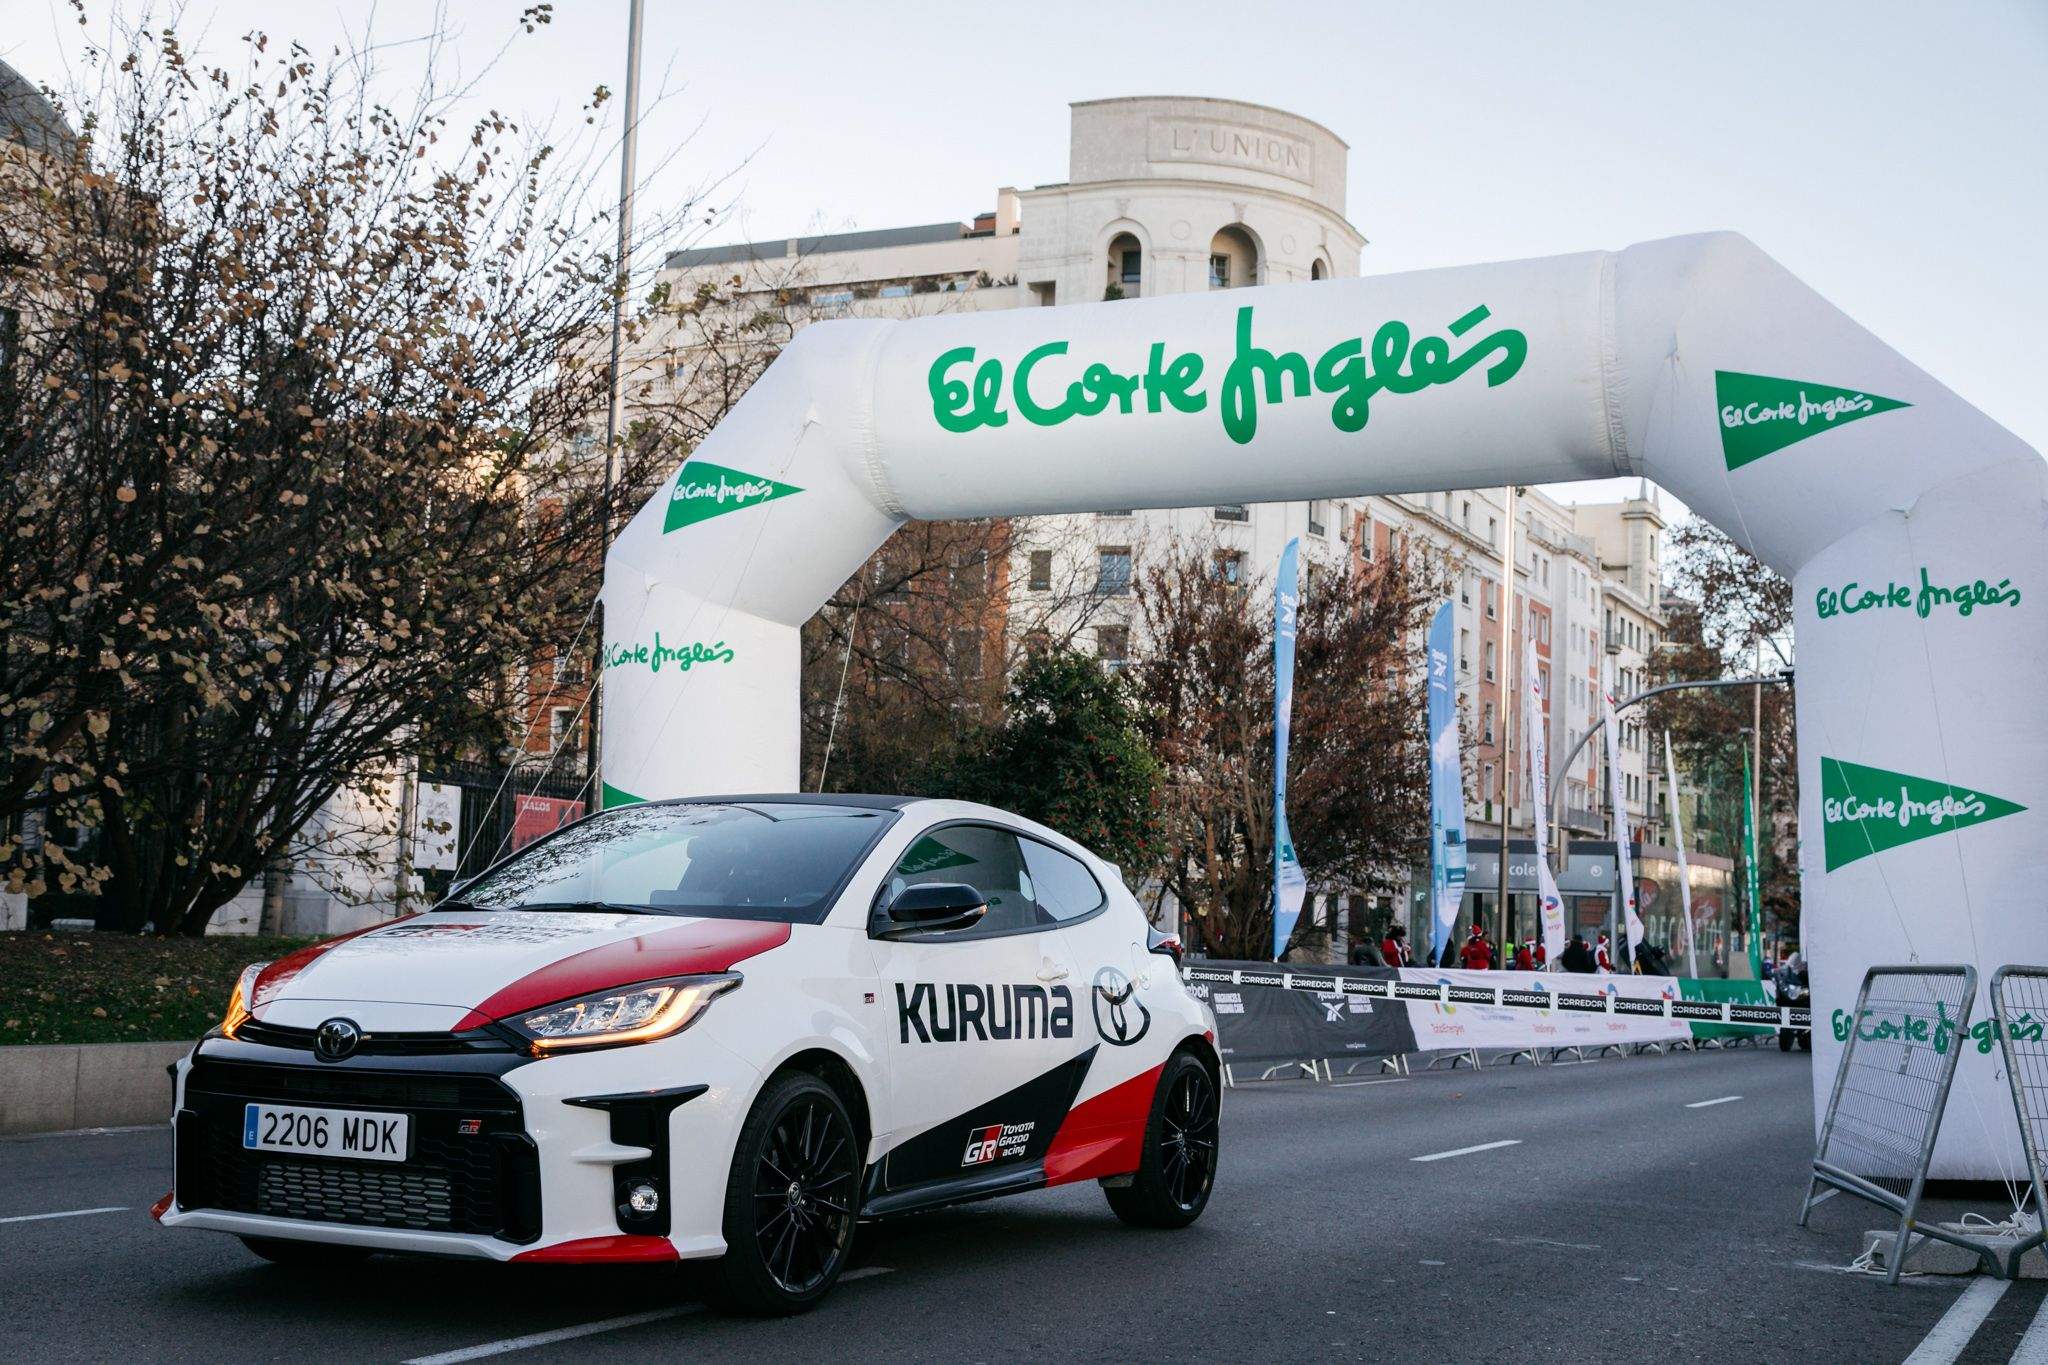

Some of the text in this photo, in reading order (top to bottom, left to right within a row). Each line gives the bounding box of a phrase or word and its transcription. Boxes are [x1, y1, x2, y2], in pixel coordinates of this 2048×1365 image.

[928, 304, 1529, 444] El Corte Inglés
[1721, 390, 1874, 428] El Corte Inglés
[685, 481, 717, 499] Corte
[716, 474, 773, 504] Inglés
[1816, 567, 2021, 619] El Corte Inglés
[651, 631, 734, 673] Inglés
[1824, 786, 1986, 827] El Corte Inglés
[248, 1131, 255, 1141] E
[262, 1112, 399, 1154] 2206 MDK
[999, 1133, 1030, 1147] GAZOO
[1003, 1121, 1035, 1135] TOYOTA
[964, 1139, 997, 1163] GR
